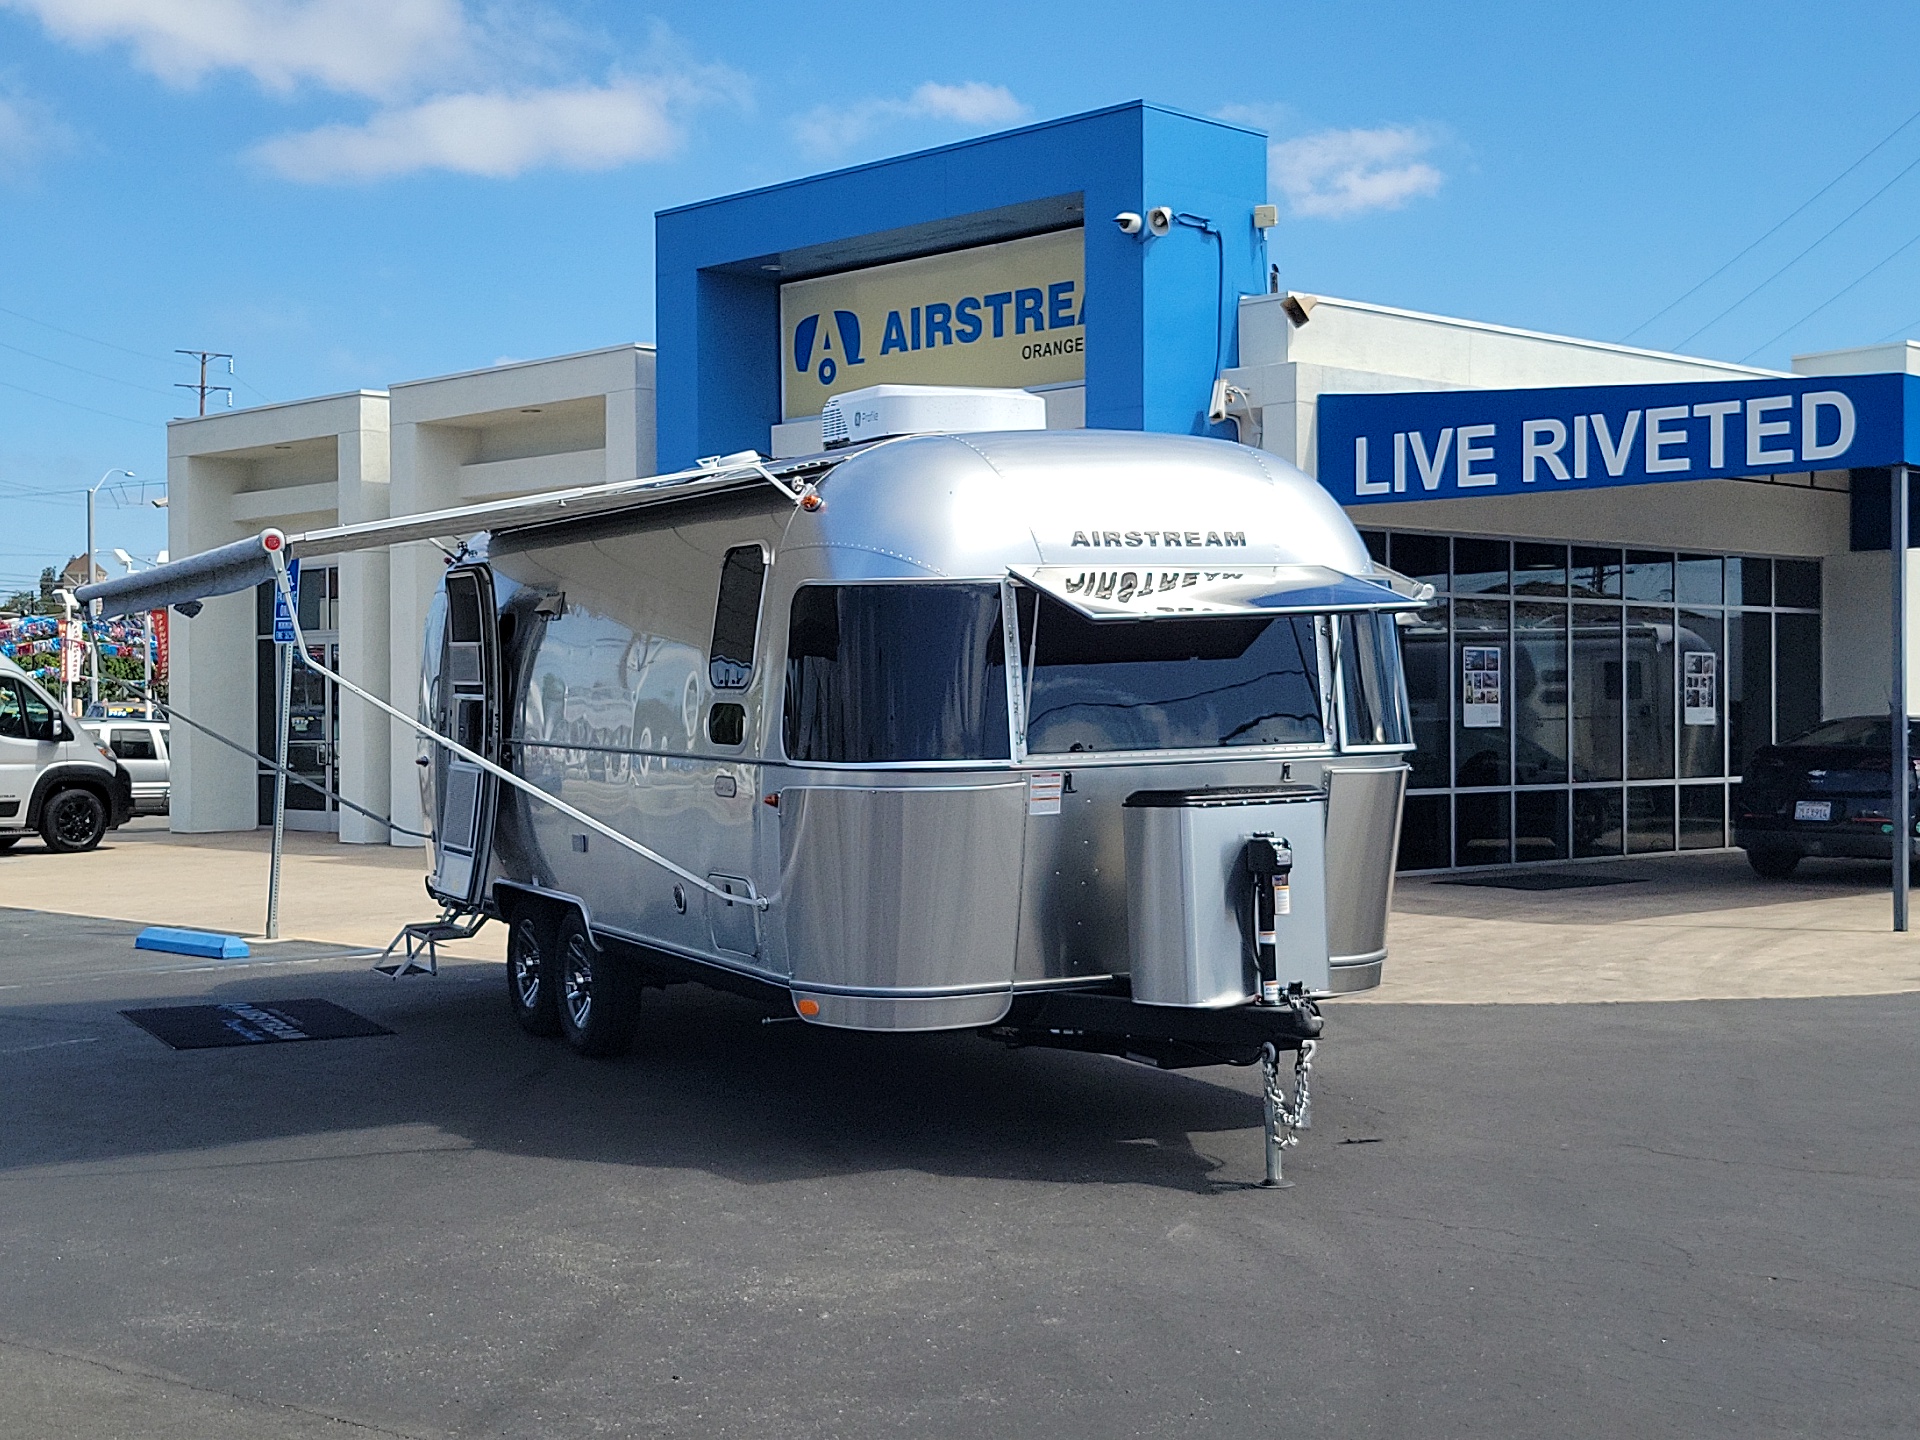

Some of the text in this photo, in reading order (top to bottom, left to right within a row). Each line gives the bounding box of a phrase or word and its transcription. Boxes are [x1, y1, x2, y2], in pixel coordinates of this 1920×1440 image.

[880, 281, 1085, 356] AIRSTRE
[1021, 337, 1084, 360] ORANGE
[1355, 390, 1856, 496] LIVE RIVETED
[1070, 530, 1247, 548] AIRSTREAM
